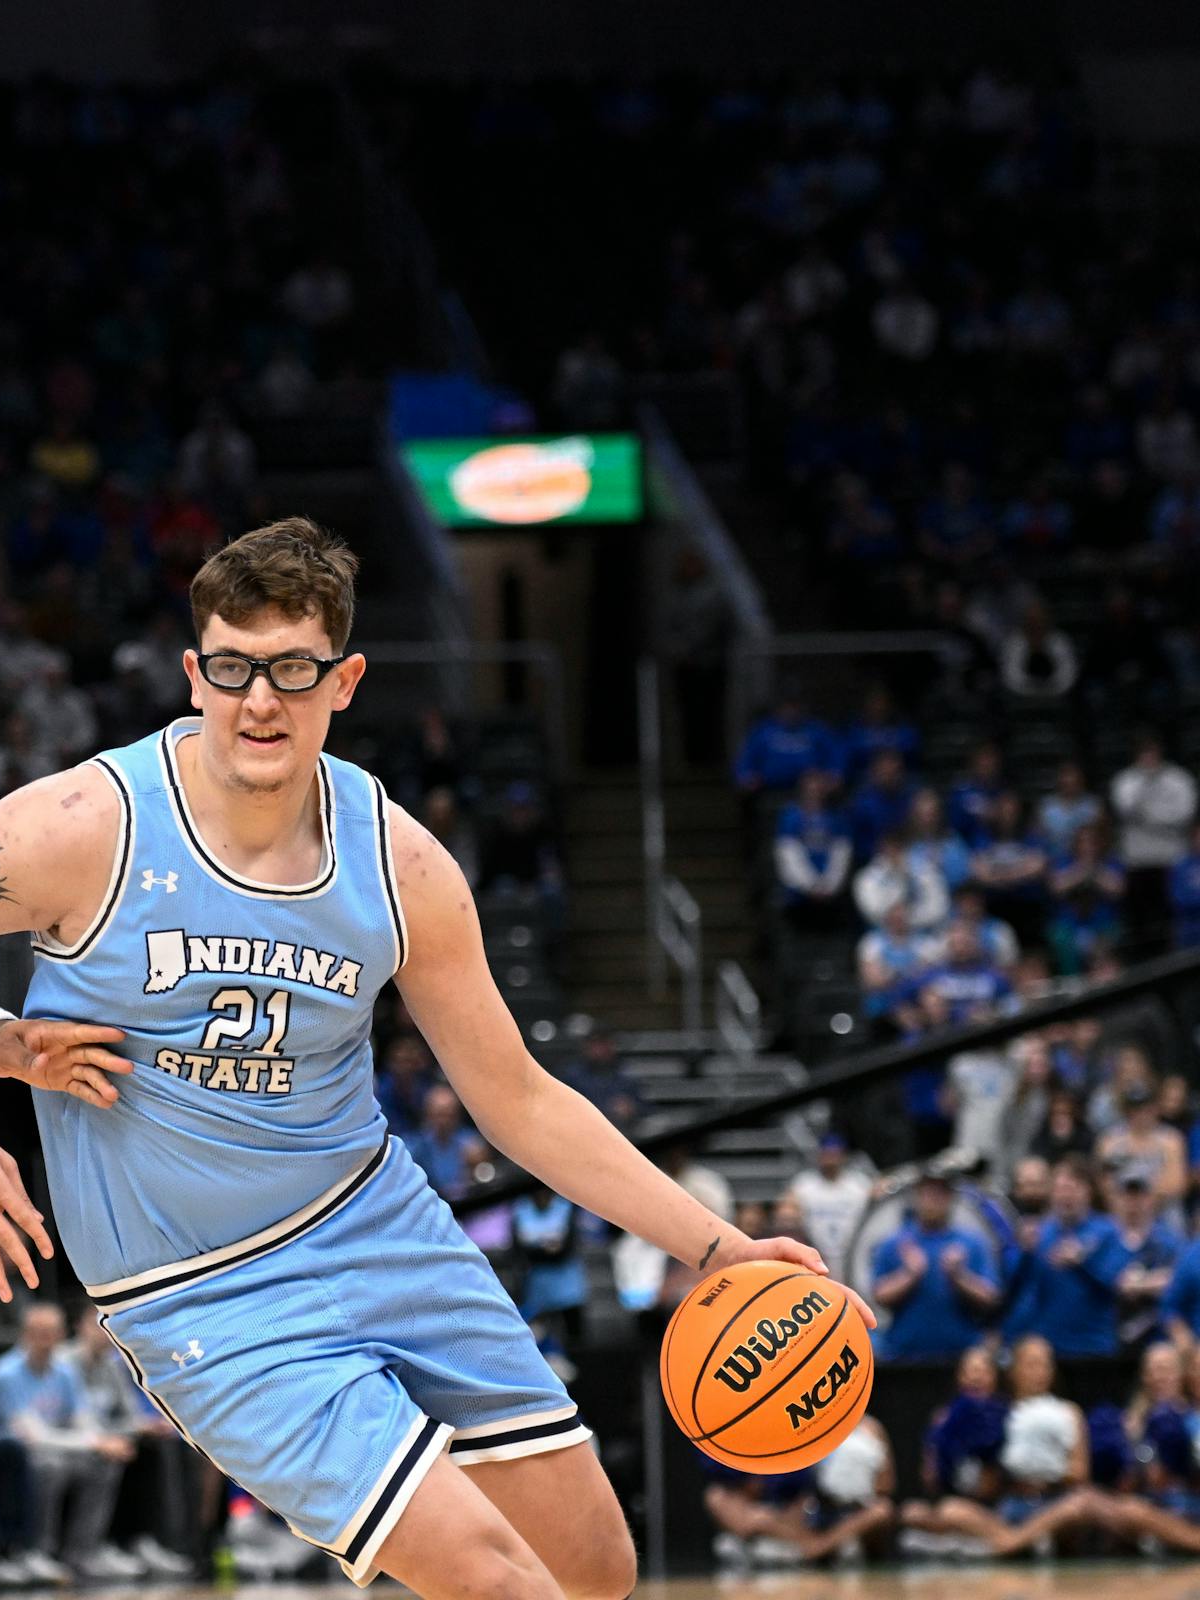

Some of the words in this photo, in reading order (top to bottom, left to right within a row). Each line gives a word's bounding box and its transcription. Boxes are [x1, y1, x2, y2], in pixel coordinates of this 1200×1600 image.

[201, 986, 292, 1057] 21
[154, 1048, 295, 1094] STATE
[712, 1290, 832, 1394] Wilson
[784, 1344, 860, 1430] NCAA
